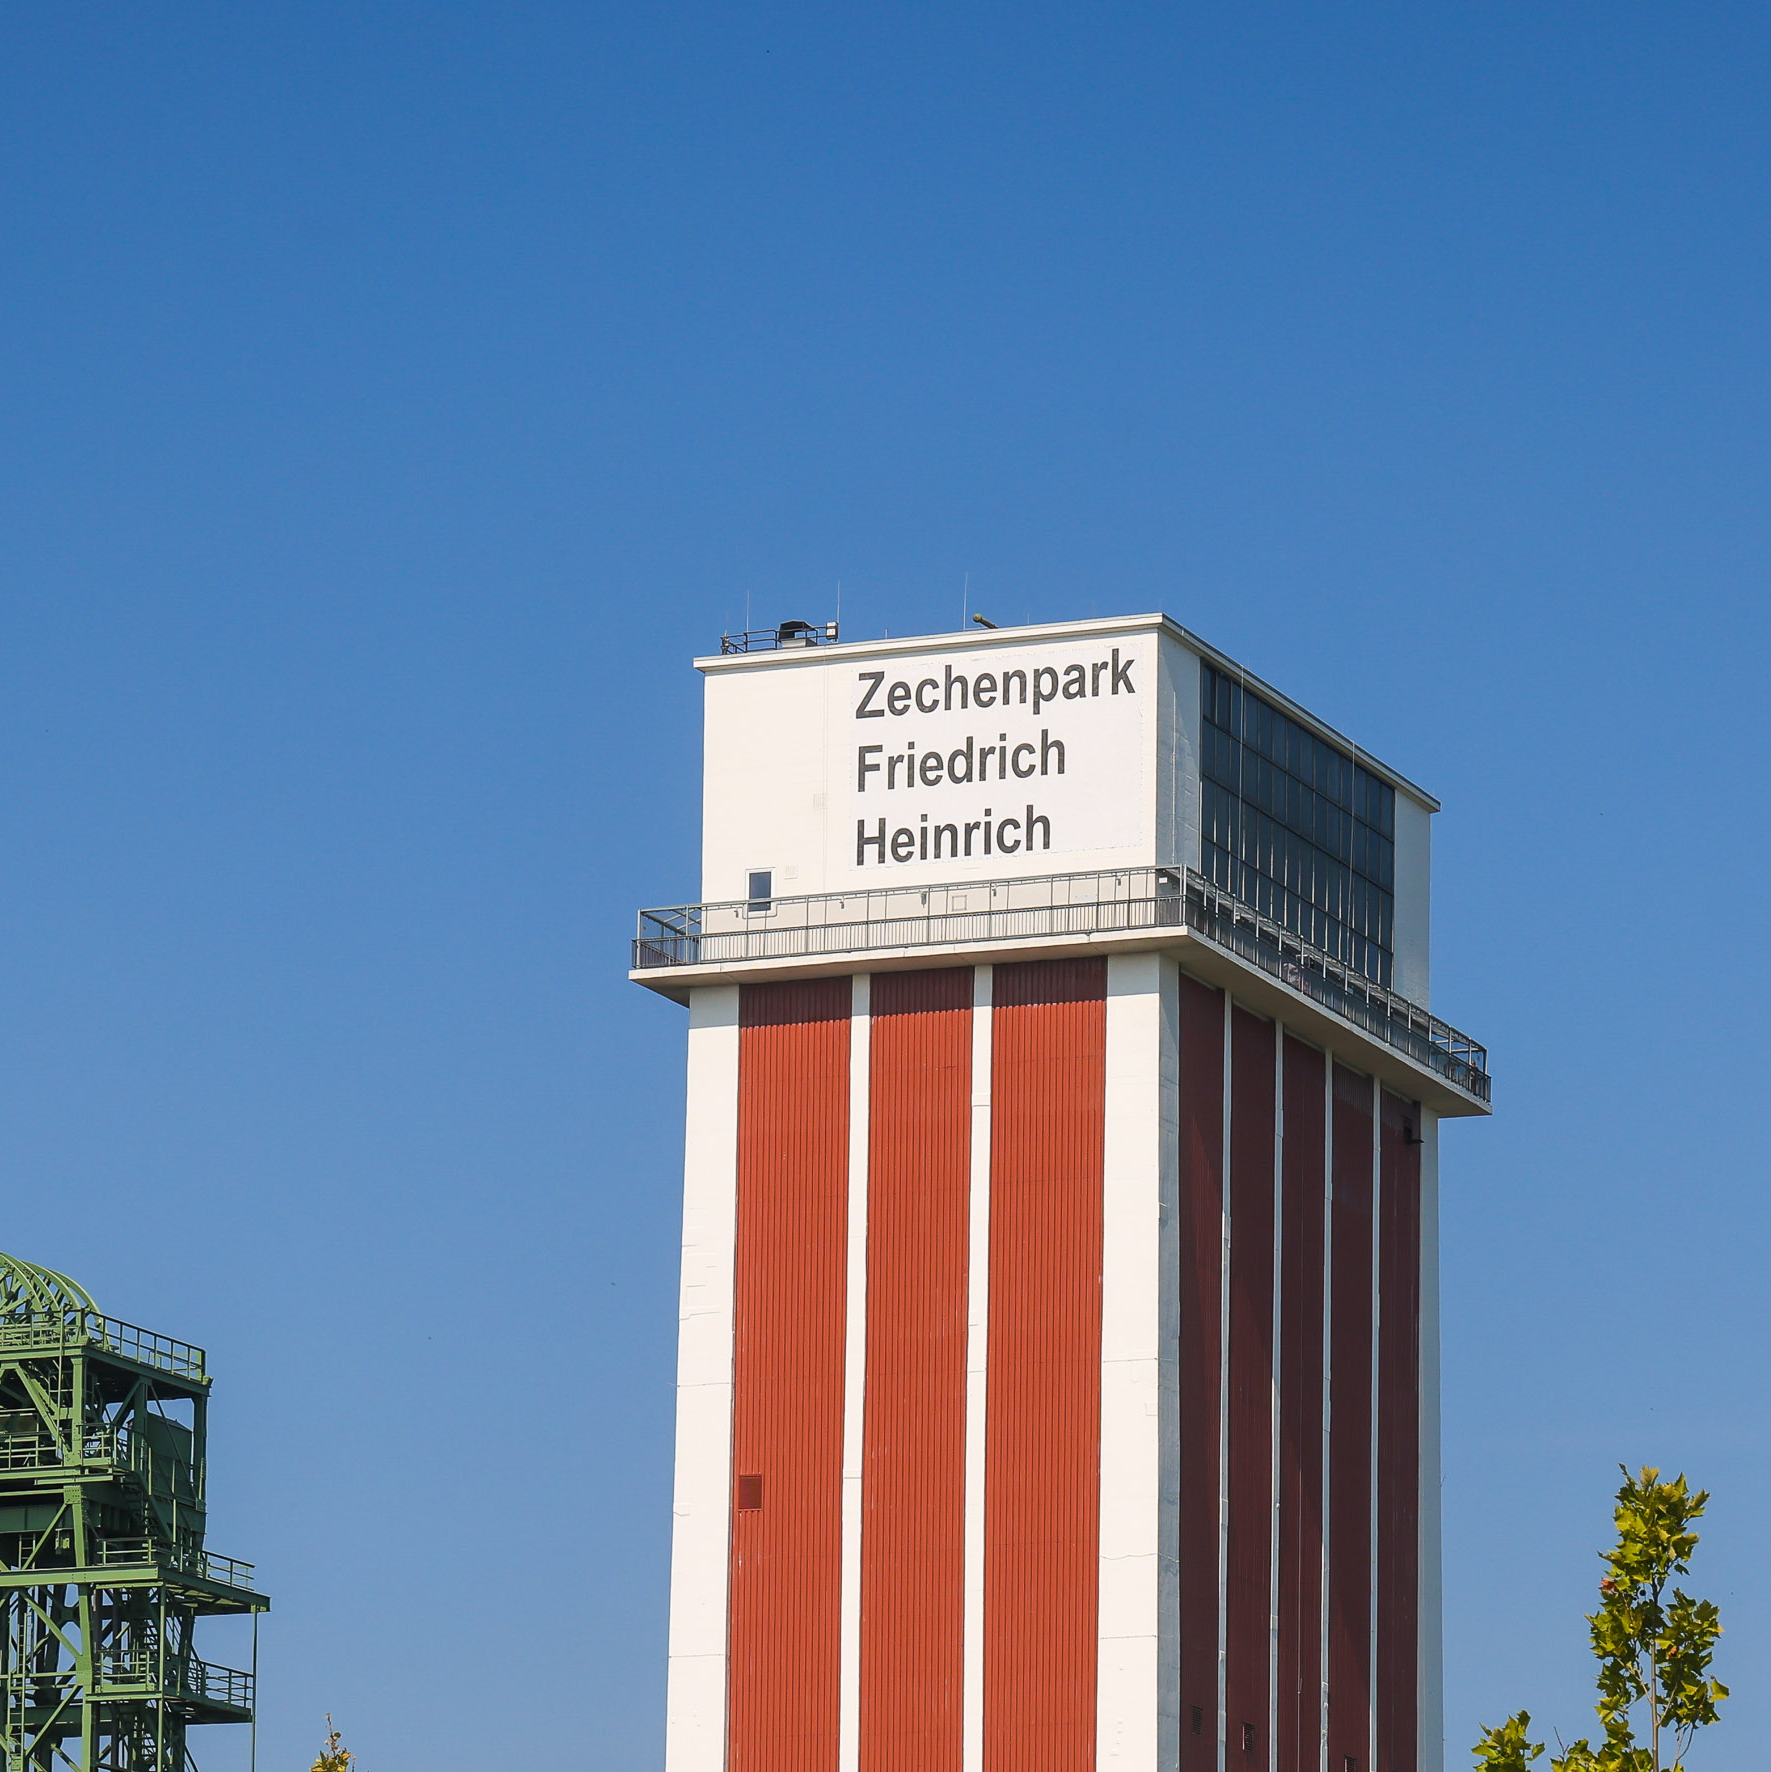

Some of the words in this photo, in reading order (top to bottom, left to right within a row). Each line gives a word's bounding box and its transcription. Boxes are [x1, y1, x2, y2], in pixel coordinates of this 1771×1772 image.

[855, 648, 1136, 719] Zechenpark
[857, 728, 1066, 793] Friedrich
[856, 804, 1051, 866] Heinrich
